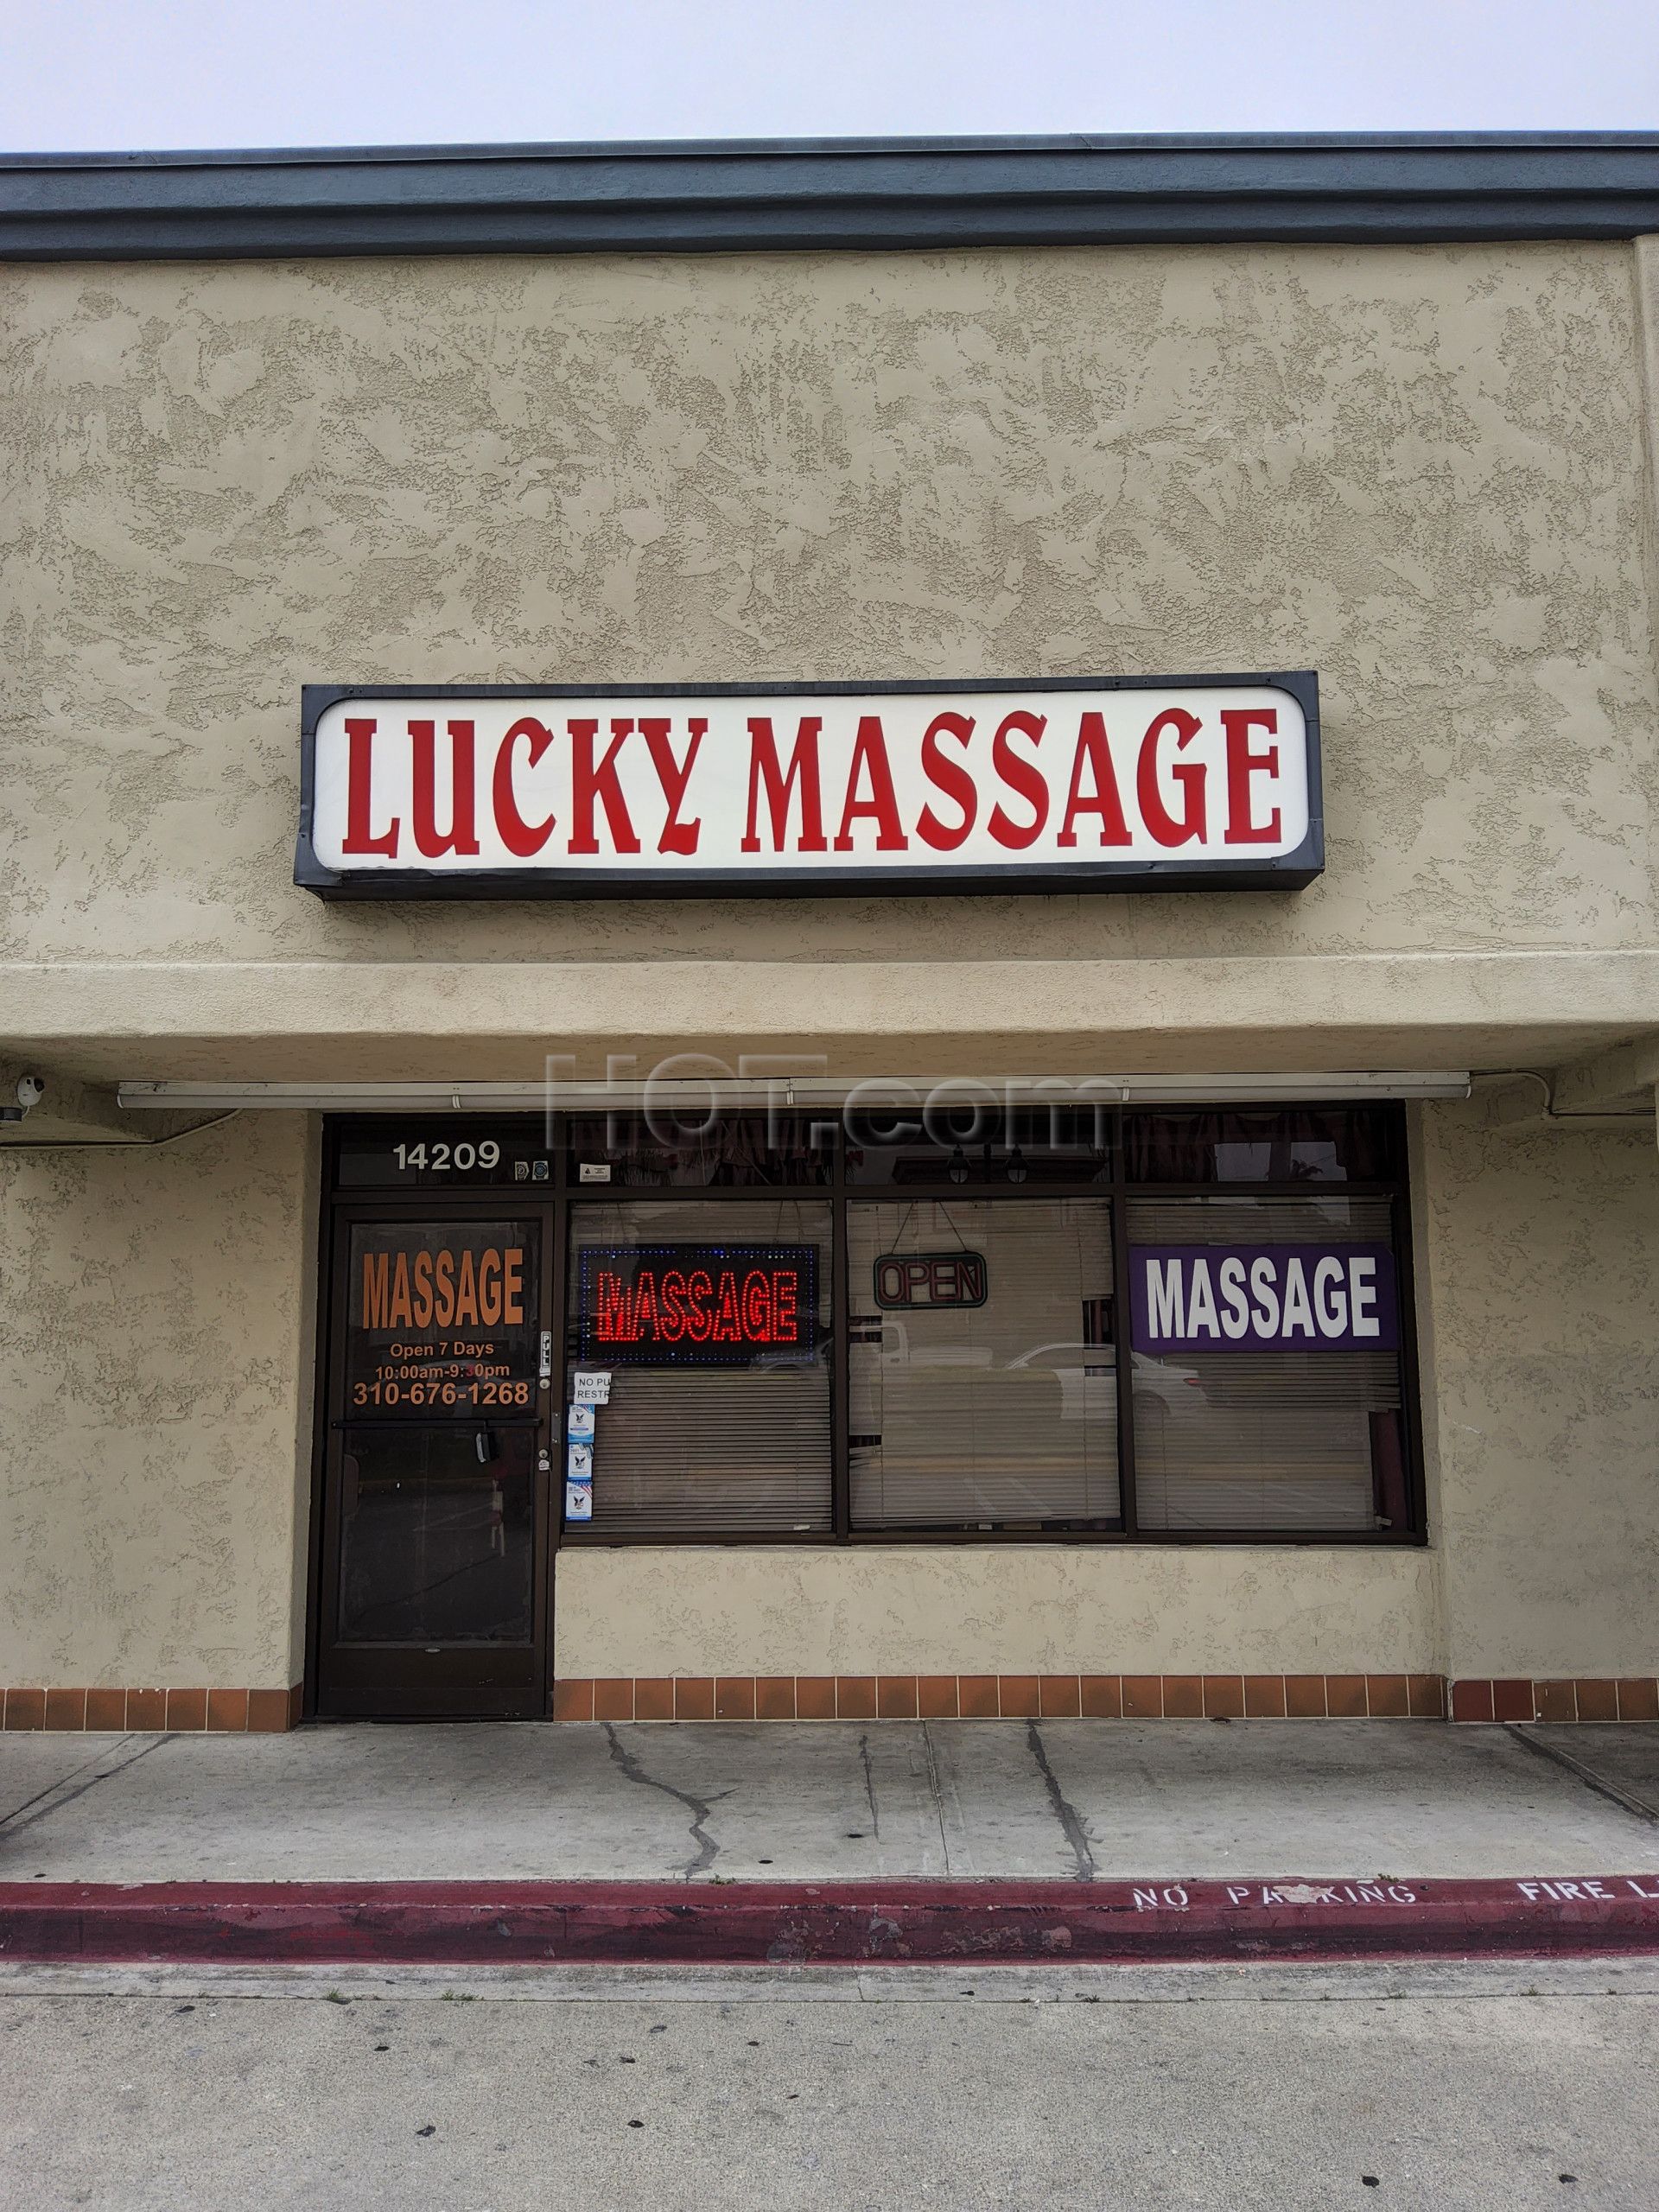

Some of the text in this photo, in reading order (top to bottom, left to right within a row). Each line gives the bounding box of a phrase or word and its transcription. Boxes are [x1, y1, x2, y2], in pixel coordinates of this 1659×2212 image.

[342, 708, 1282, 858] LUCKY MASSAGE
[393, 1141, 499, 1169] 14209
[362, 1248, 523, 1329] MASSAGE
[880, 1262, 982, 1302] OPEN
[1146, 1256, 1380, 1339] MASSAGE
[597, 1270, 798, 1341] MASSAGE
[390, 1341, 494, 1360] Open 7 Days
[353, 1382, 529, 1405] 310-676-1268
[579, 1378, 594, 1387] NO
[1134, 1879, 1659, 1906] NO PAKING FIRE L
